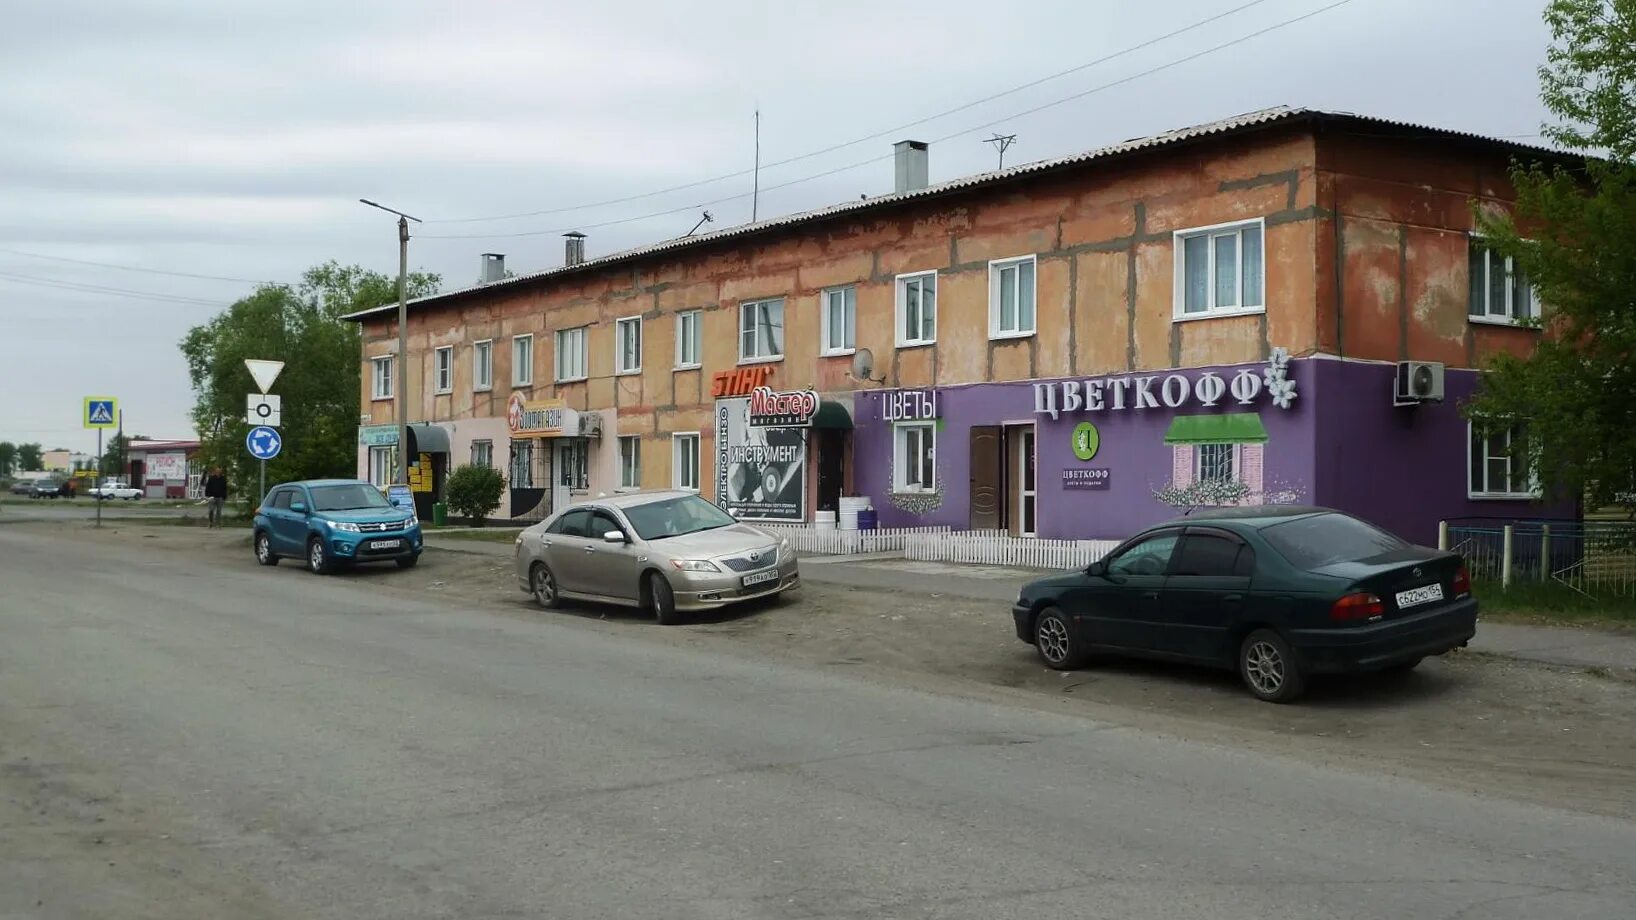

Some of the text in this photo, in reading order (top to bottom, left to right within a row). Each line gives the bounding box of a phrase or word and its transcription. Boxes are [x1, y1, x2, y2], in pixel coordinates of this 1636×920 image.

[750, 390, 813, 420] Мастер
[882, 390, 936, 424] ЦВЕТЫ
[1033, 369, 1263, 420] ЦВЕТКОФФ
[731, 446, 797, 462] ИНСТРУМЕНТ
[1063, 470, 1109, 479] ЦВЕТКОФФ
